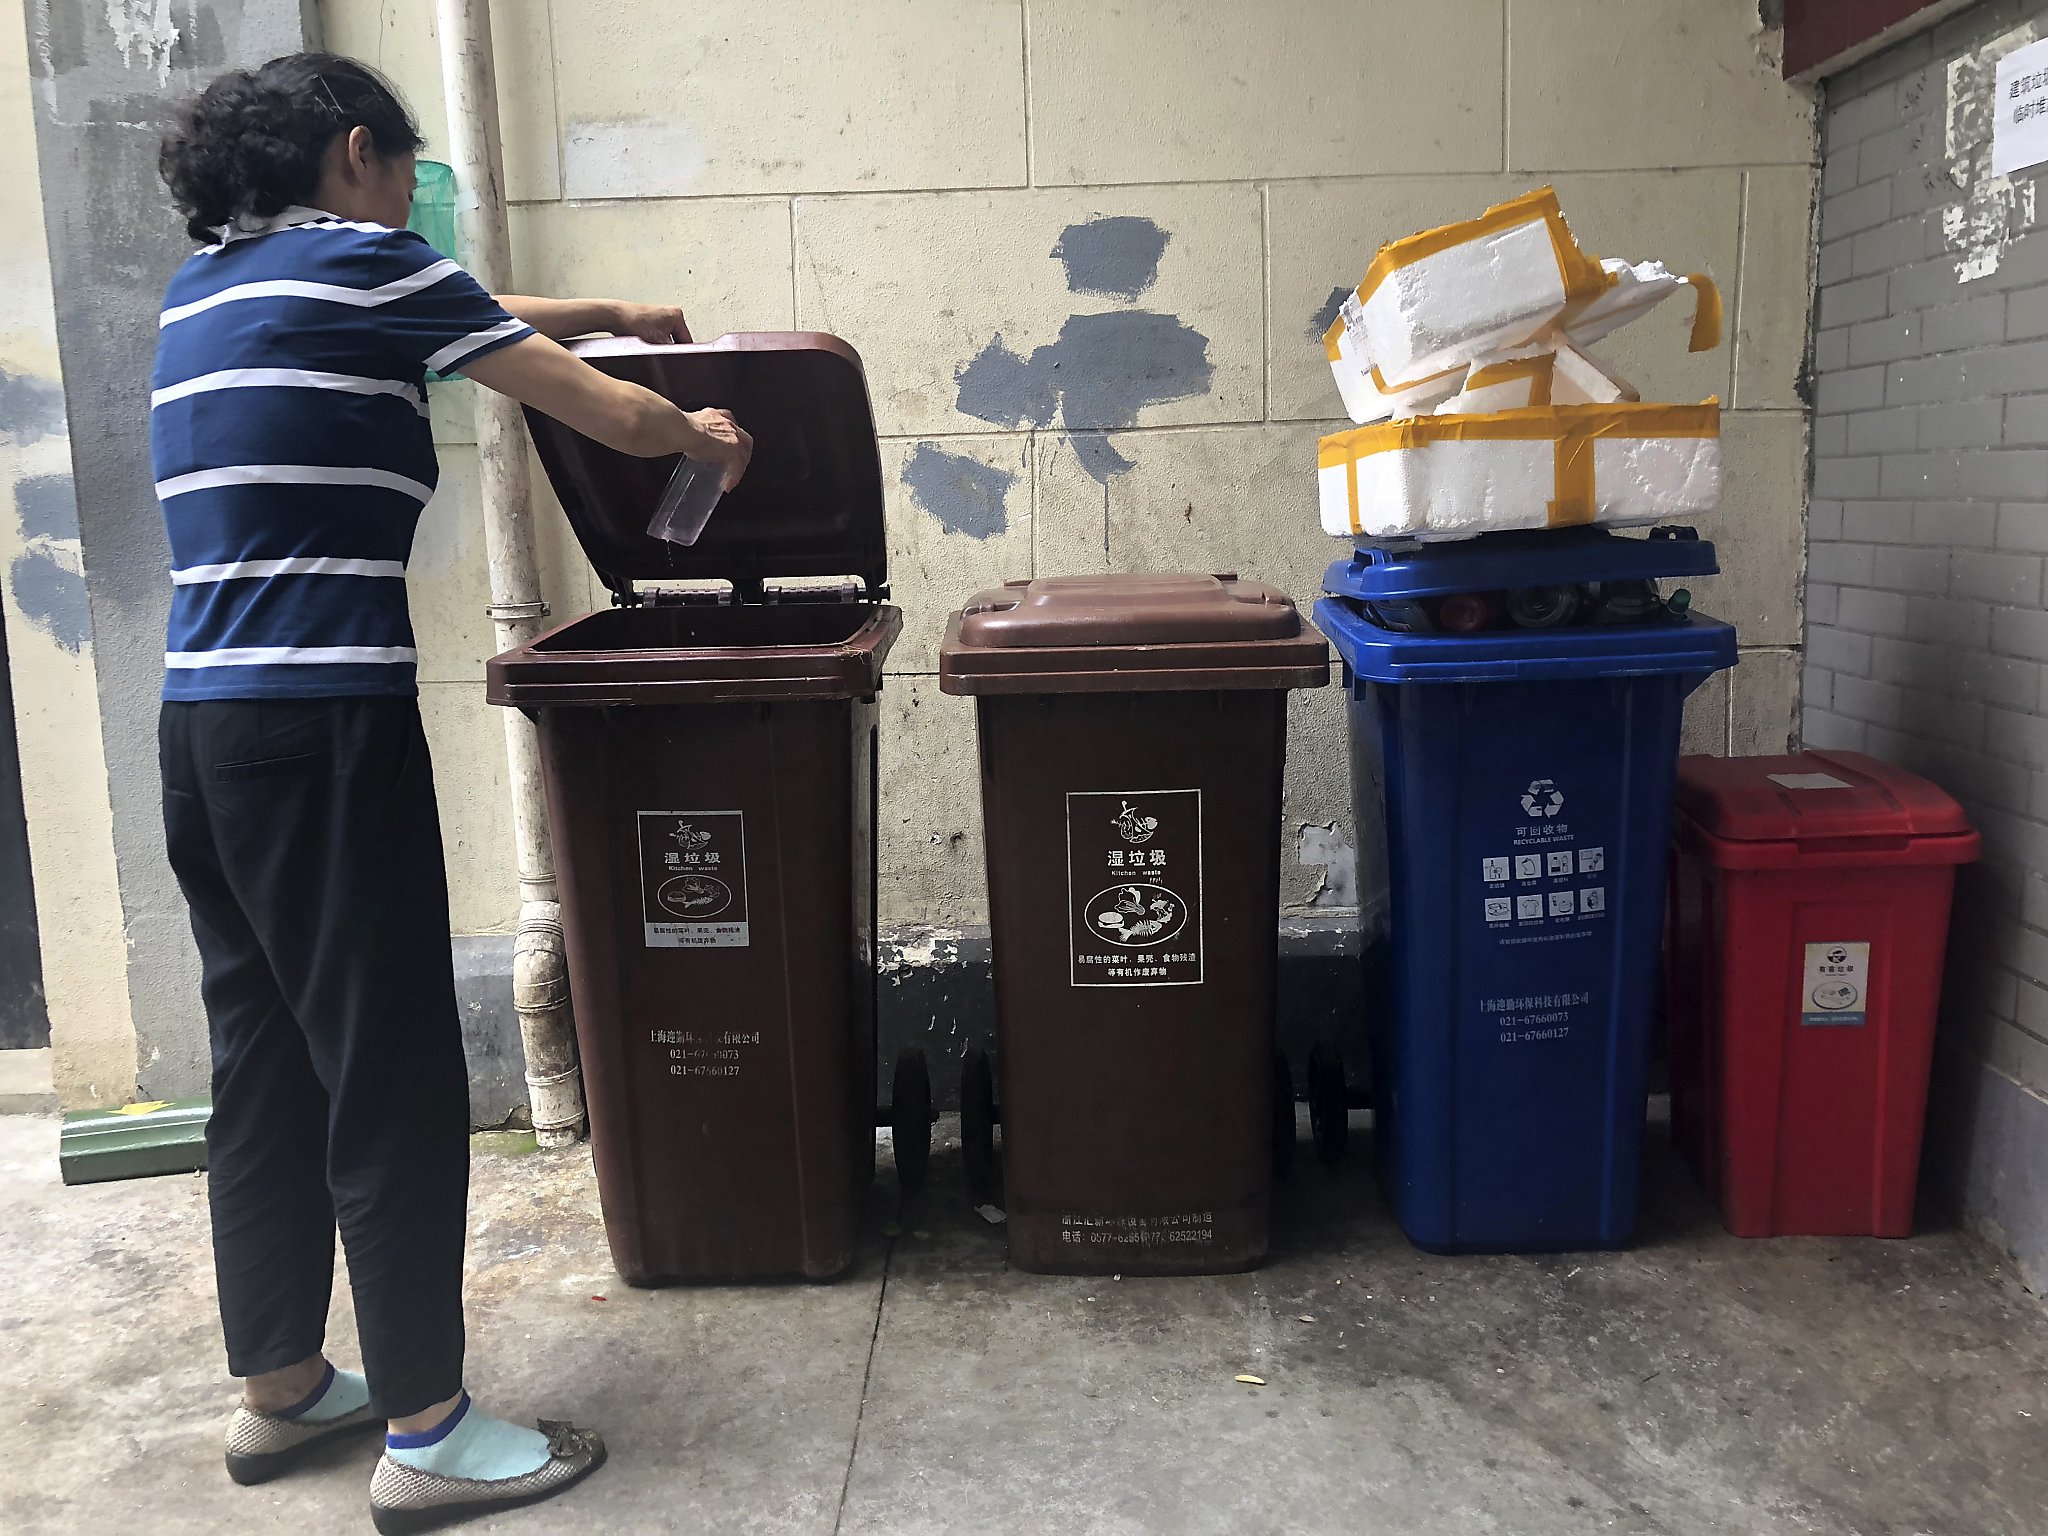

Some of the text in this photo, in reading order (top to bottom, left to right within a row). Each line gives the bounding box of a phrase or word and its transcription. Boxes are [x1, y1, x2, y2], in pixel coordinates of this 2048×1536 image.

[2013, 96, 2048, 124] 临时堆
[1515, 824, 1568, 837] 可回收物
[1513, 834, 1574, 845] RECYCLABLE WASTE
[664, 852, 721, 864] 湿垃圾
[1107, 850, 1167, 867] 湿垃圾
[1499, 1011, 1569, 1026] 021-67660073
[1500, 1027, 1569, 1042] 021-67660127
